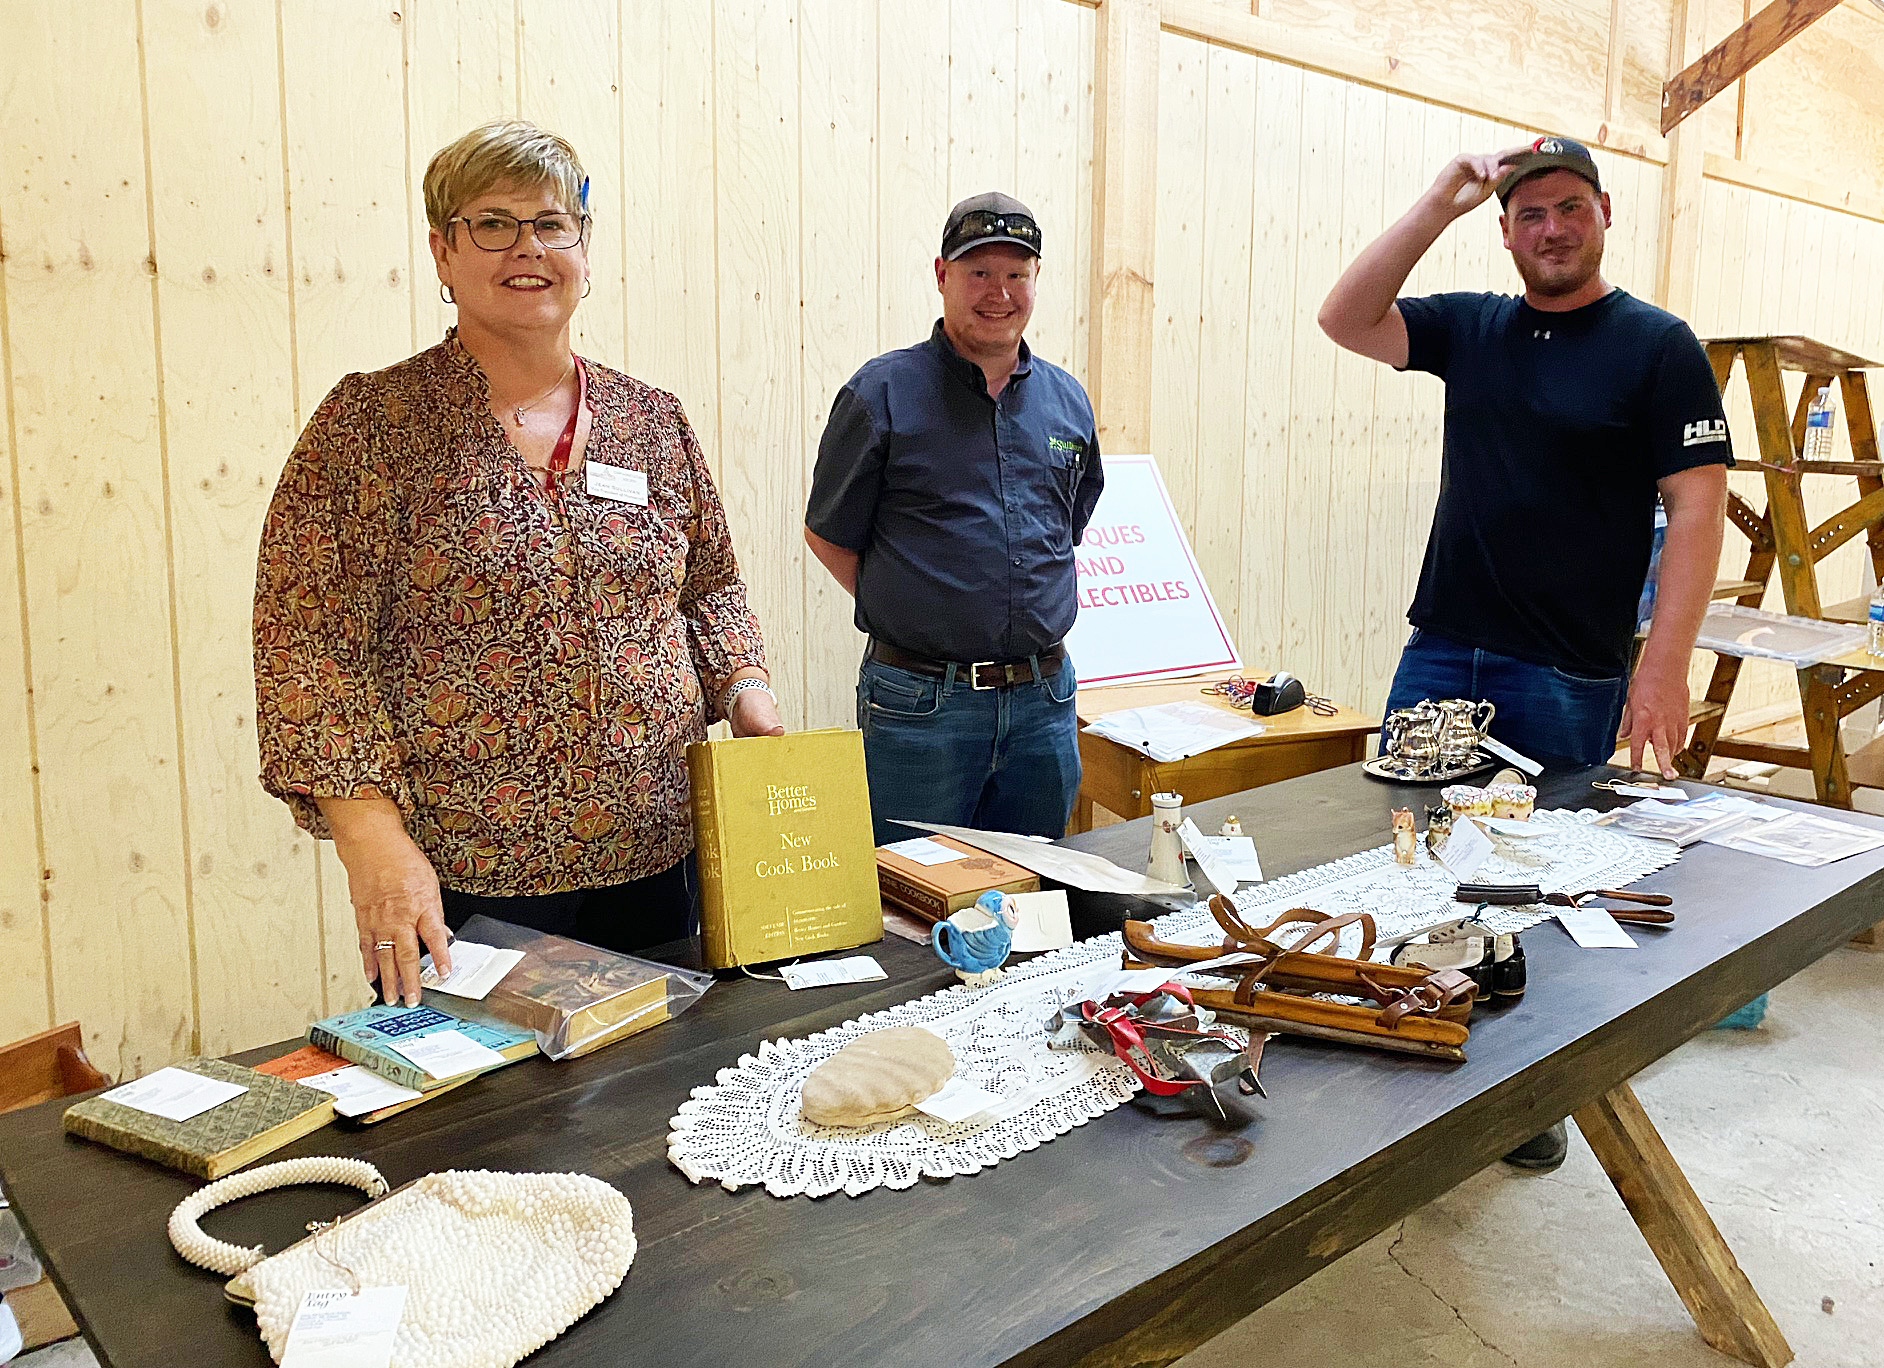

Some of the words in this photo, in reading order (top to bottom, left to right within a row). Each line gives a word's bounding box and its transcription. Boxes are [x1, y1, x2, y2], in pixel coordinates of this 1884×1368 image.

[1082, 525, 1146, 549] QUES
[1075, 556, 1125, 577] AND
[766, 784, 808, 800] Better
[768, 796, 817, 816] Homes
[780, 832, 812, 850] New
[755, 858, 795, 878] Cook
[801, 852, 840, 872] Book
